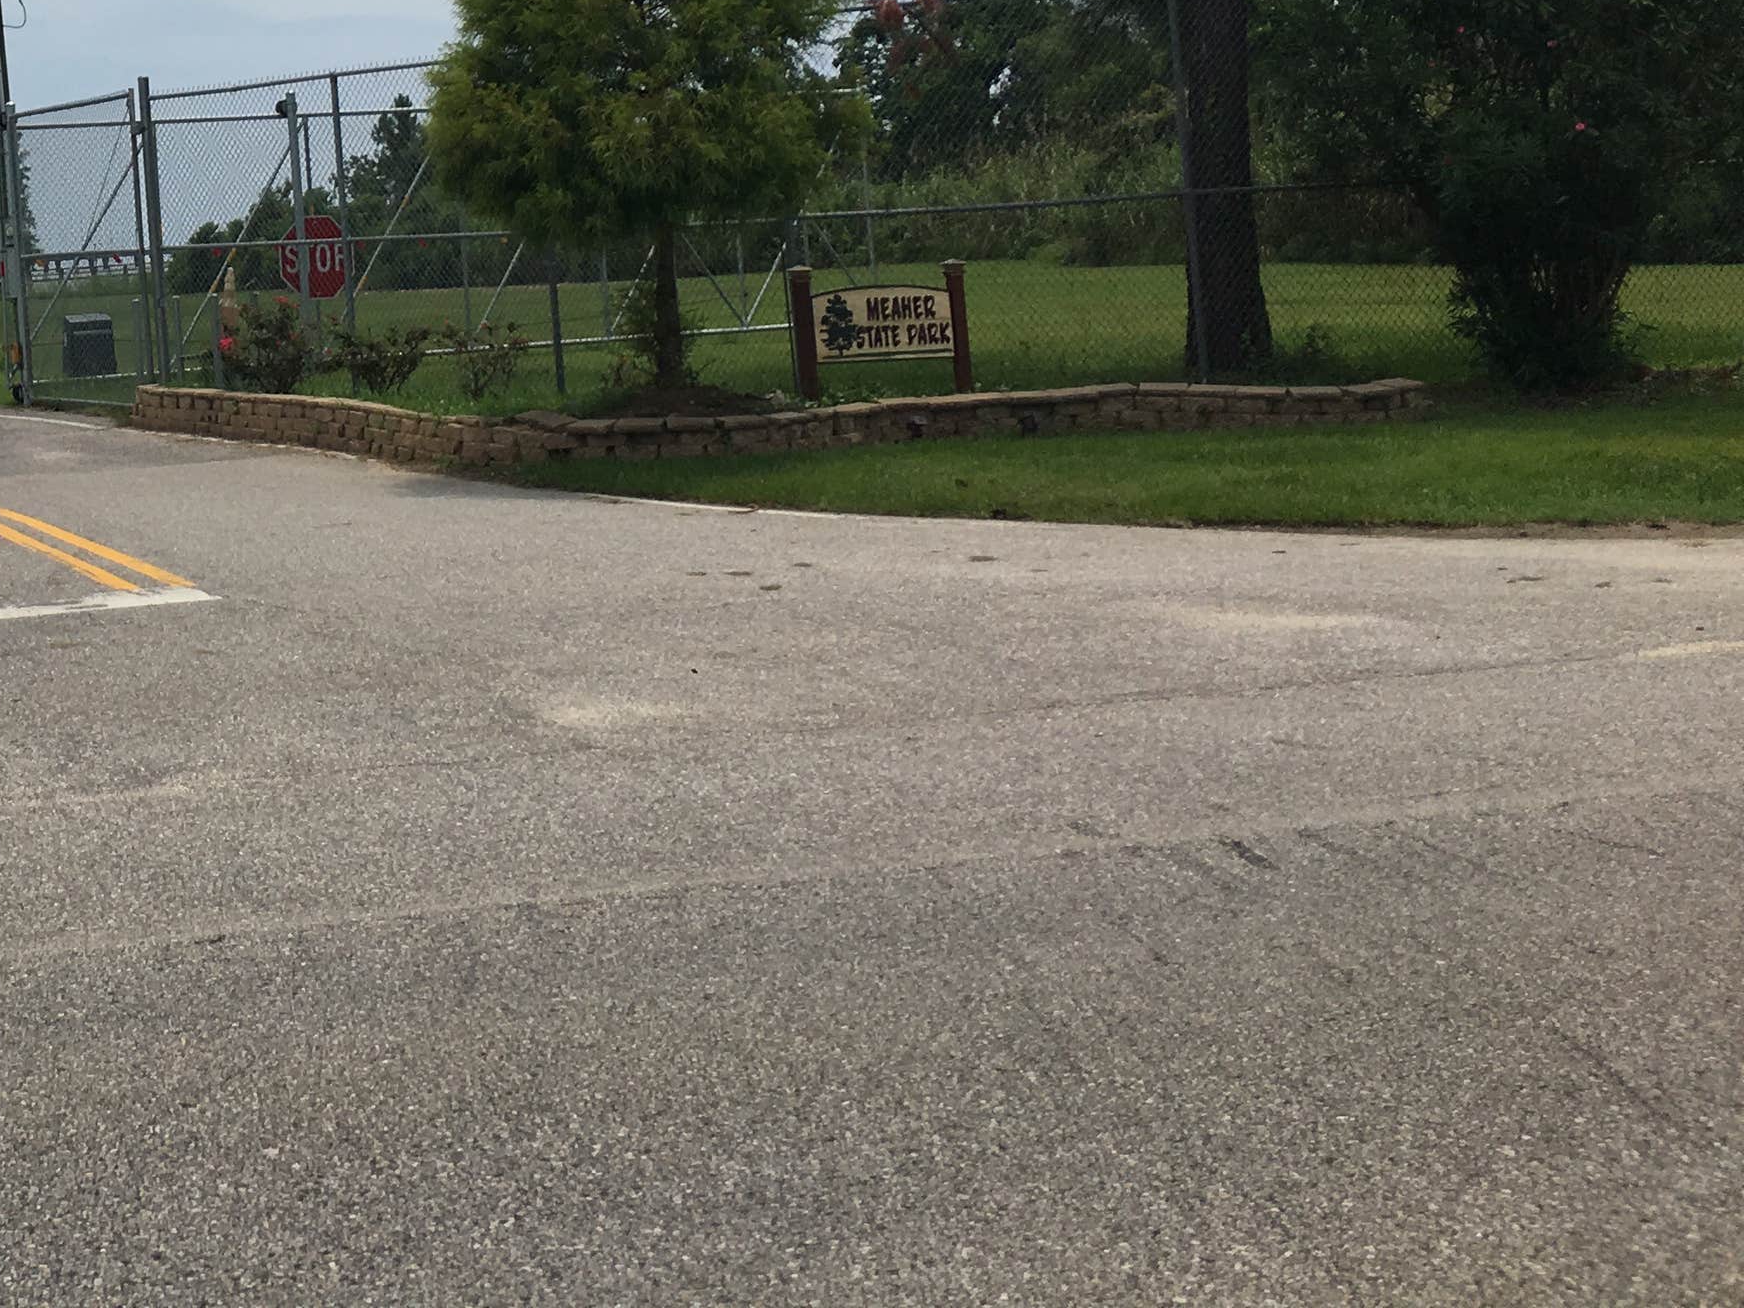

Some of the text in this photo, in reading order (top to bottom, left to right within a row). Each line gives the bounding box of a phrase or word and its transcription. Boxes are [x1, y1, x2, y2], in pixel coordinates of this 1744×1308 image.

[285, 243, 346, 273] SOP
[866, 295, 936, 321] MEAHER
[856, 322, 951, 349] STATE PARK
